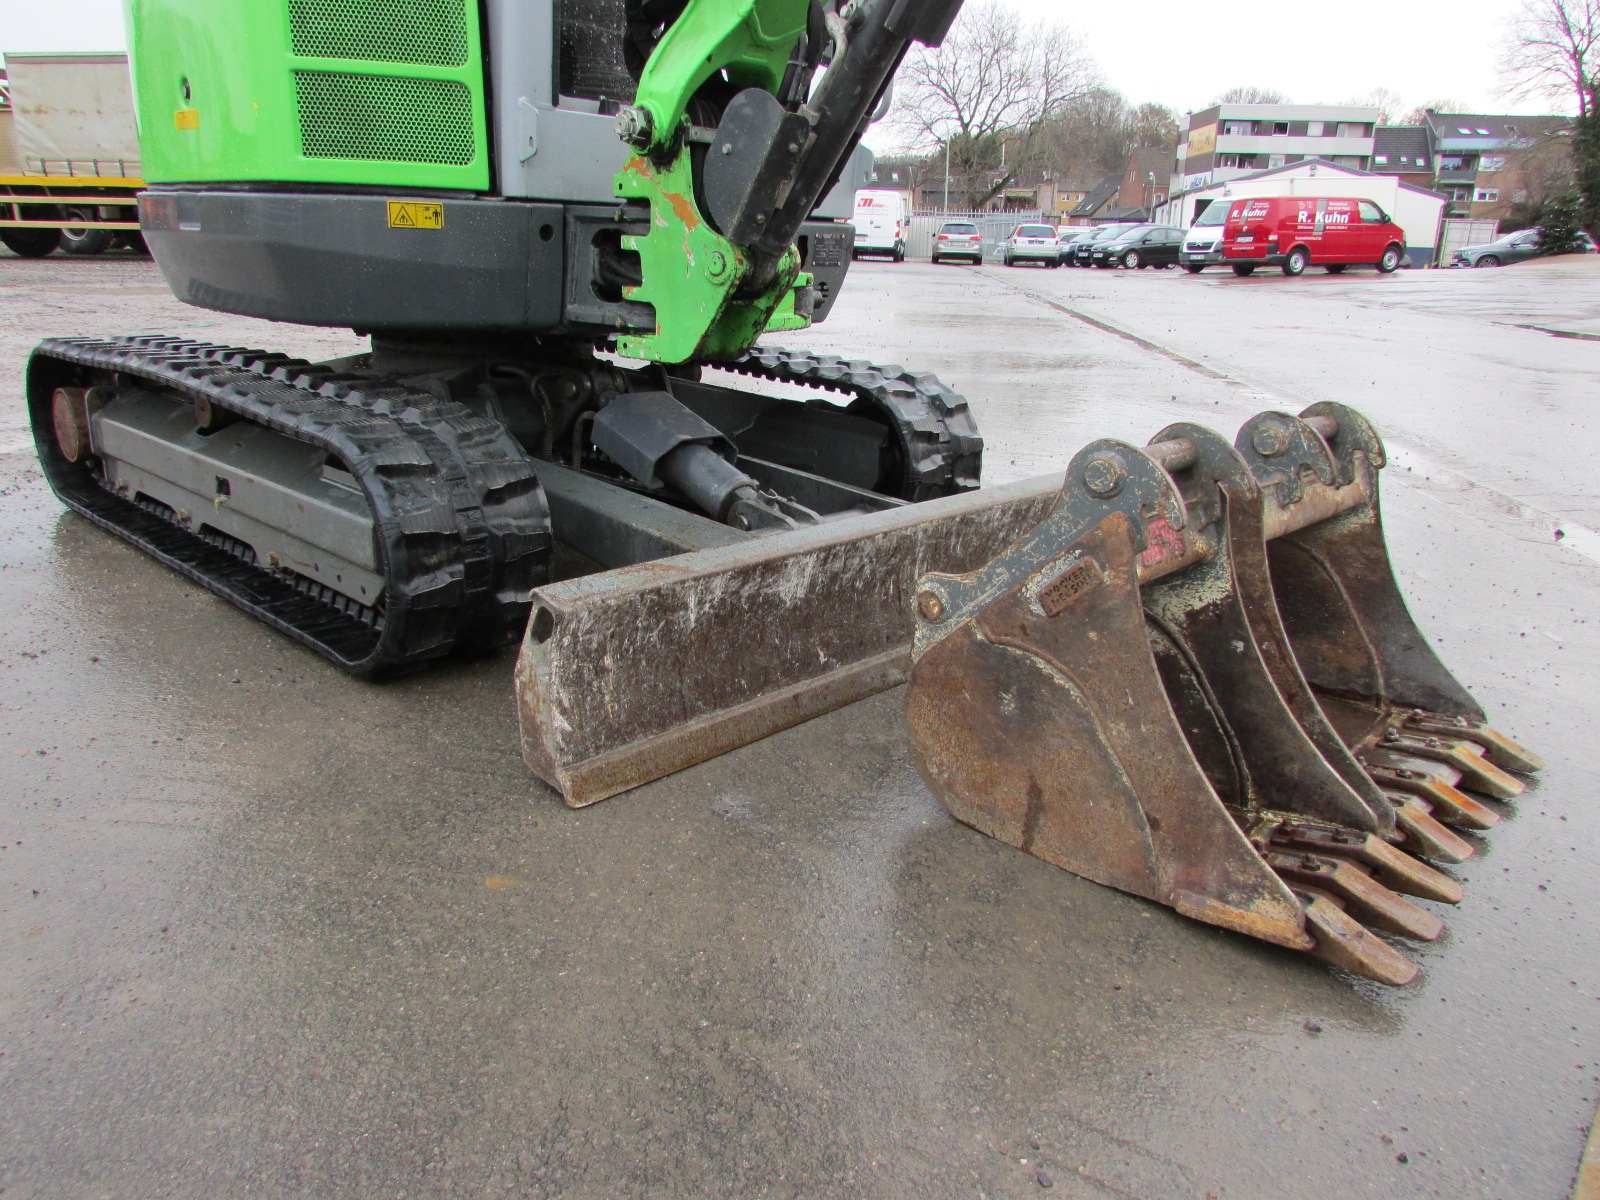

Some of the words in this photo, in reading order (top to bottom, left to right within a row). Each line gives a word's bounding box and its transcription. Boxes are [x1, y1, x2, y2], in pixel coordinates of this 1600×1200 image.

[1231, 209, 1240, 218] R.
[1241, 208, 1267, 217] Kuhn
[1297, 210, 1312, 223] R.
[1315, 210, 1349, 224] Kuhn
